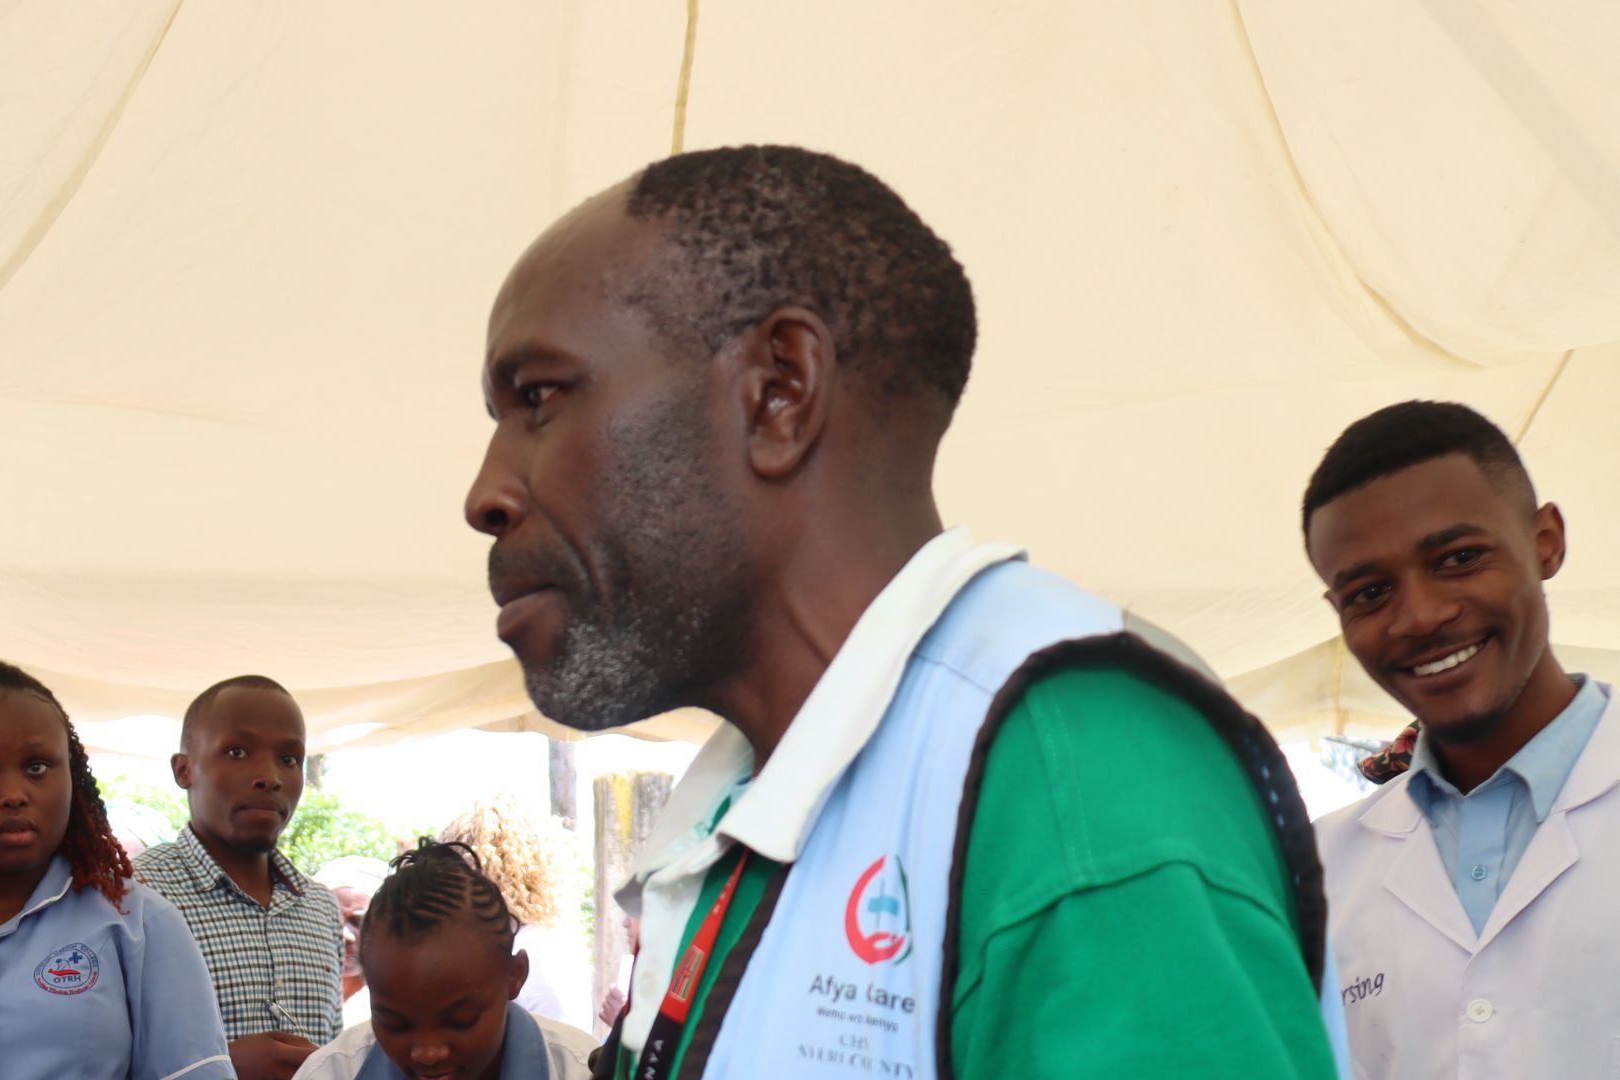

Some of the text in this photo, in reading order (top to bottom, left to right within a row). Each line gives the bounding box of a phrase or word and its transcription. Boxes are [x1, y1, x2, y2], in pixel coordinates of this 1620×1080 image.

[53, 975, 82, 983] OTRH
[808, 974, 857, 1002] Afya
[1341, 973, 1384, 1006] rsing
